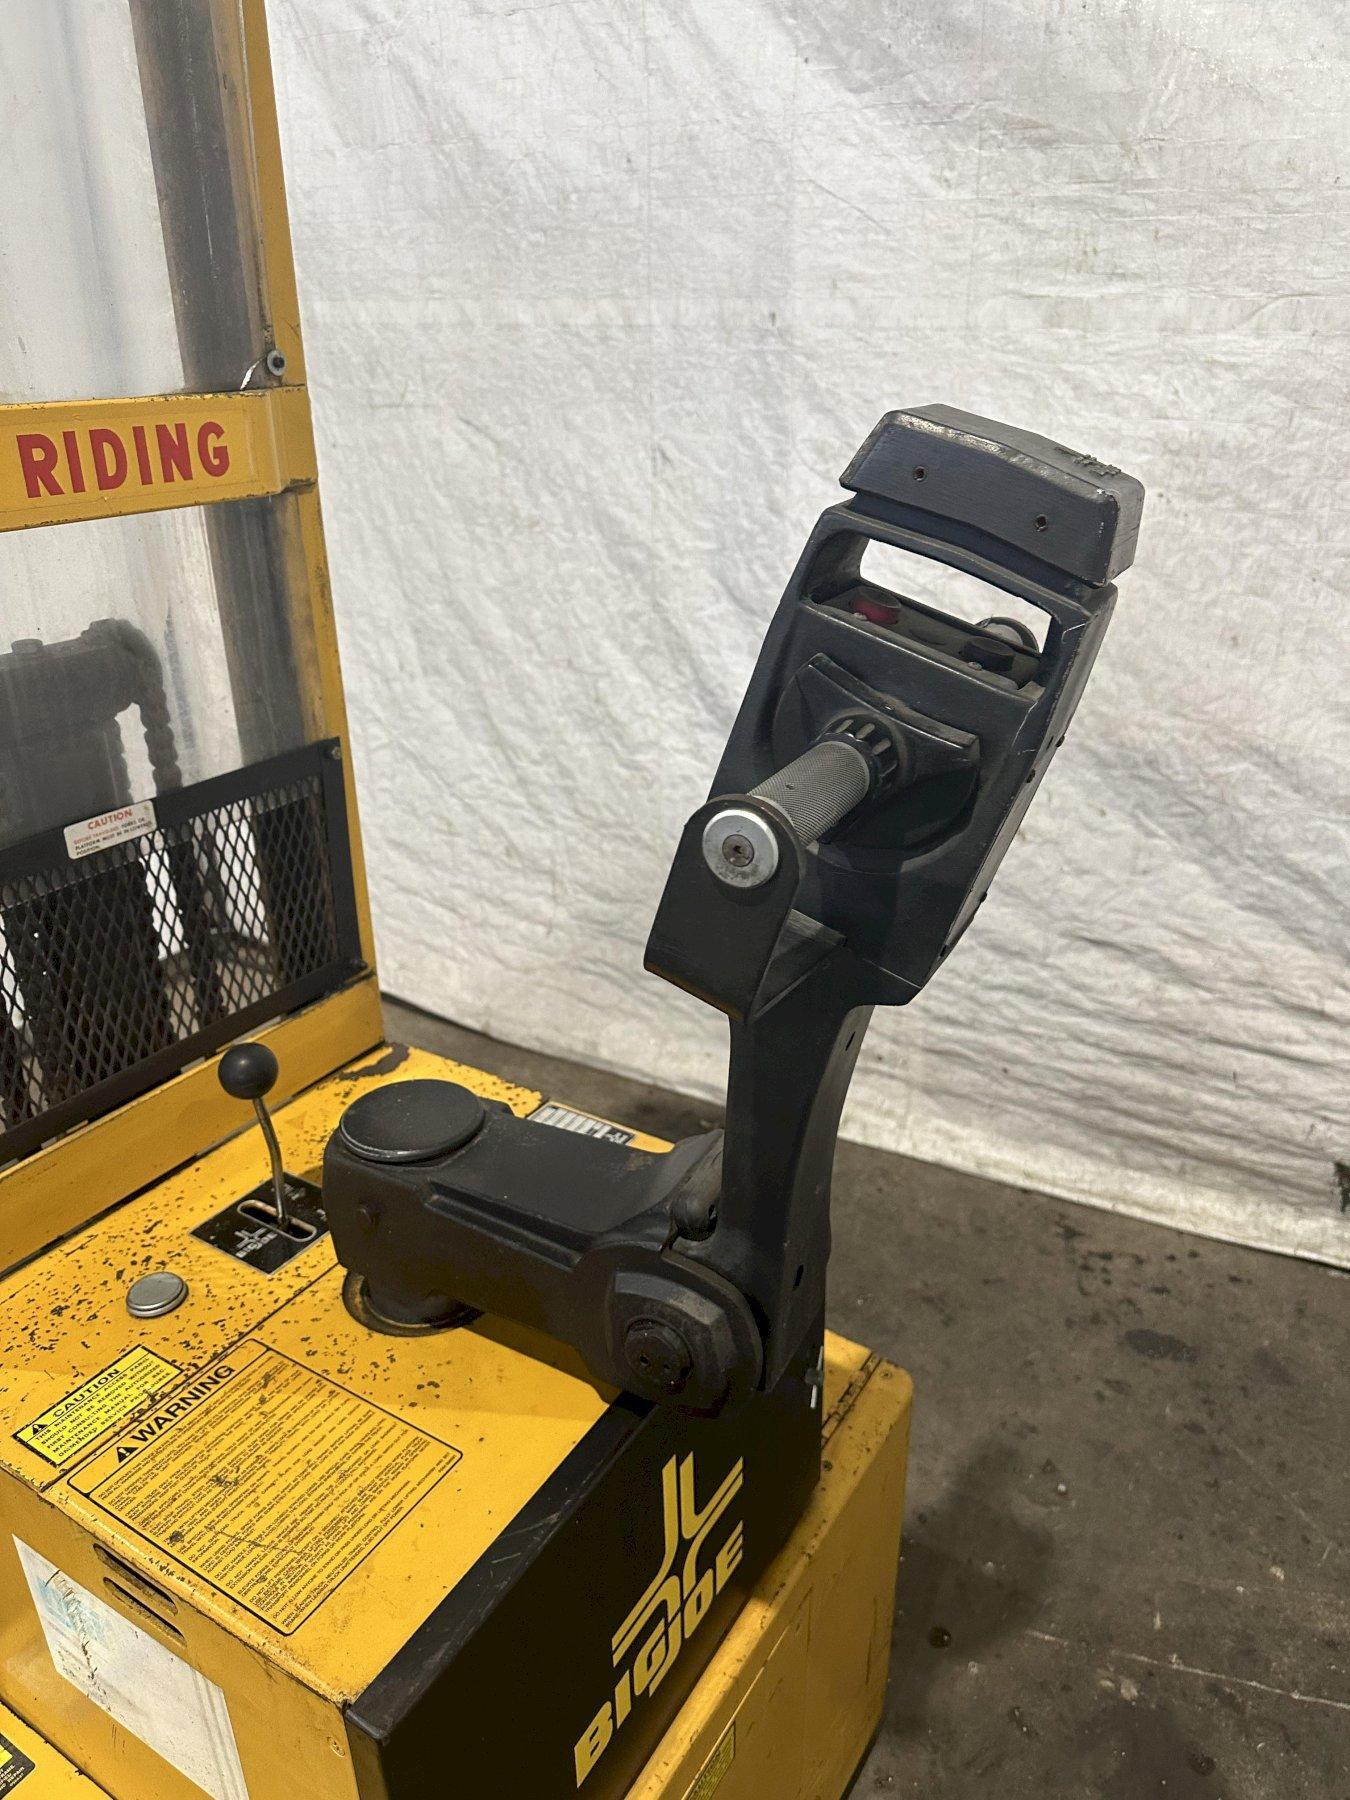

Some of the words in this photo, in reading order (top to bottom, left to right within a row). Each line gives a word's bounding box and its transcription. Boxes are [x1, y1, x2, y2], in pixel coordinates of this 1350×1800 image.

[16, 421, 230, 498] RIDING
[88, 809, 132, 829] CAUTION
[53, 1368, 120, 1417] CAUTION
[130, 1364, 235, 1443] WARNING
